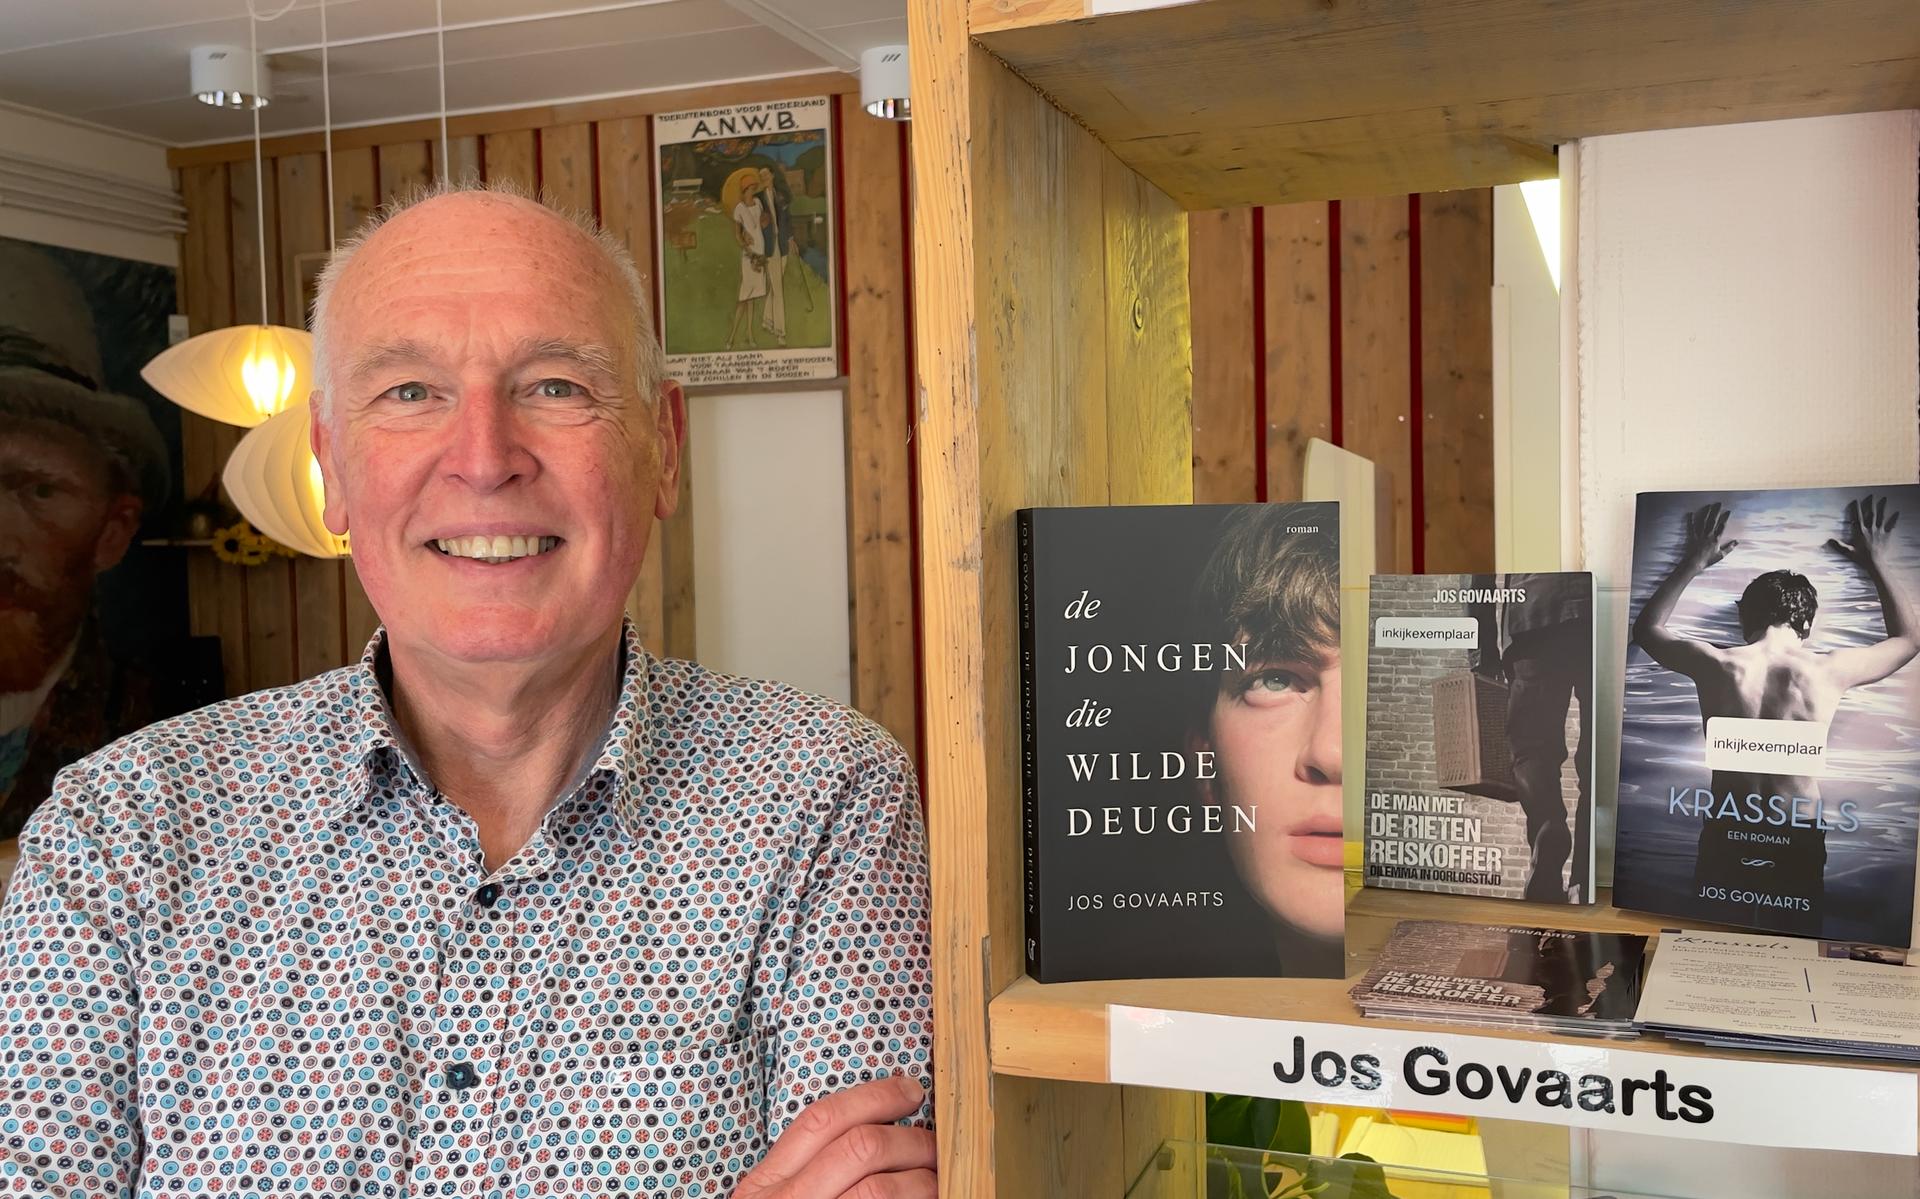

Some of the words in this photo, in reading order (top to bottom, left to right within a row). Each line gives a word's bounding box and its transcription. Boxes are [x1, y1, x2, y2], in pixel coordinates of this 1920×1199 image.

[736, 104, 762, 113] VOOR
[766, 99, 826, 110] NEDERLAND
[1286, 524, 1319, 534] roman
[1064, 590, 1101, 620] de
[1433, 589, 1458, 604] JOS
[1458, 588, 1526, 604] GOVAARTS
[1381, 627, 1475, 642] inkijkexemplaar
[1065, 642, 1249, 675] JONGEN
[1065, 699, 1112, 728] die
[1713, 737, 1823, 757] inkijkexemplaar
[1066, 751, 1218, 782] WILDE
[1371, 793, 1390, 810] DE
[1392, 794, 1430, 812] MAN
[1432, 796, 1465, 813] MET
[1668, 786, 1859, 833] KRASSELS
[1067, 804, 1259, 837] DEUGEN
[1370, 811, 1398, 838] DE
[1402, 812, 1481, 844] RIETEN
[1727, 830, 1748, 841] EEN
[1750, 833, 1791, 845] ROMAN
[1370, 839, 1502, 873] REISKOFFER
[1370, 864, 1418, 880] DILEMMA
[1420, 867, 1431, 881] IN
[1432, 868, 1502, 886] OORLOGSTIJD
[1068, 894, 1104, 911] JOS
[1114, 891, 1224, 910] GOVAARTS
[1699, 886, 1726, 901] JOS
[1730, 889, 1810, 911] GOVAARTS
[1379, 975, 1412, 984] DE
[1415, 979, 1503, 993] RIETEN
[1386, 970, 1406, 978] DE
[1410, 973, 1450, 982] MAN
[1450, 976, 1489, 985] MET
[1372, 982, 1521, 1004] REISKOFFER
[1272, 1035, 1383, 1091] Jos
[1402, 1043, 1715, 1125] Govaarts
